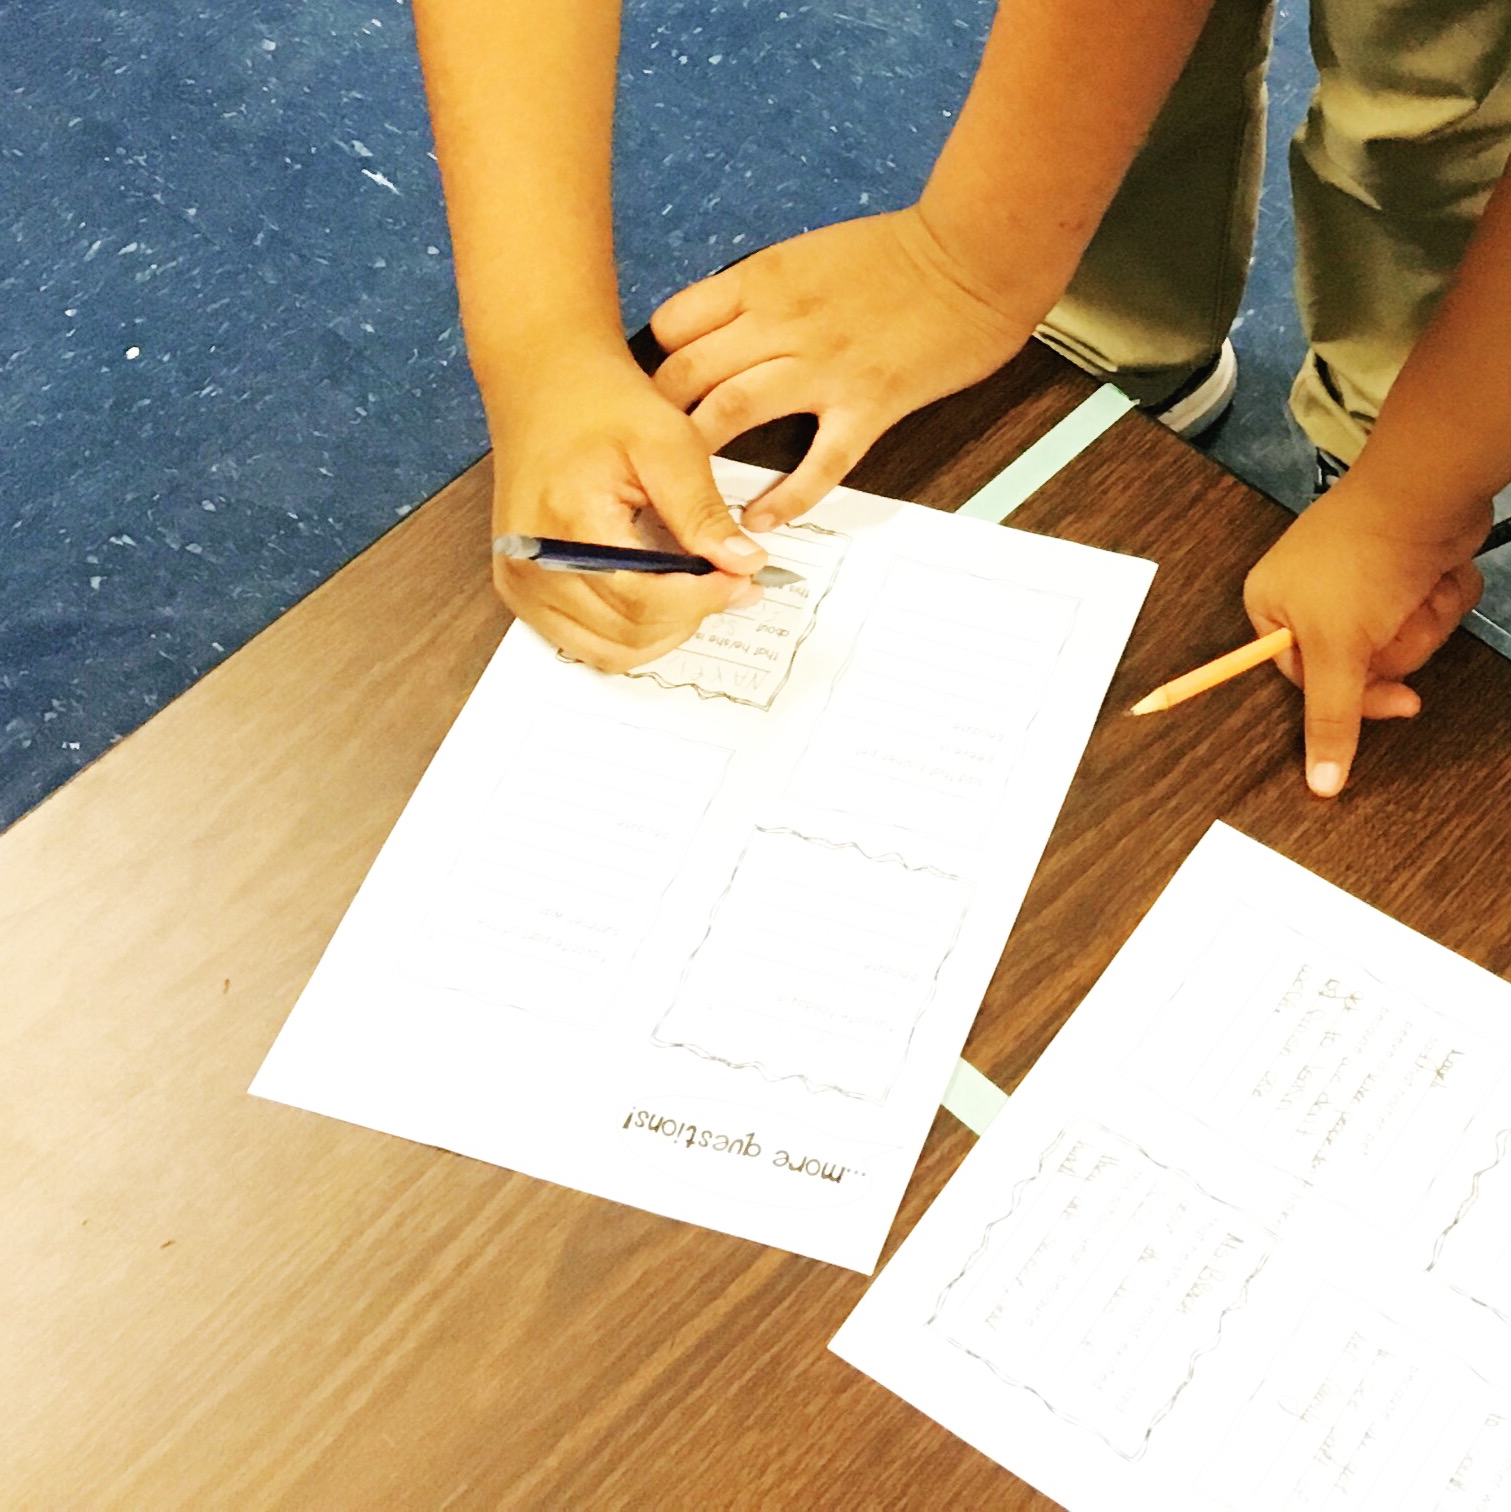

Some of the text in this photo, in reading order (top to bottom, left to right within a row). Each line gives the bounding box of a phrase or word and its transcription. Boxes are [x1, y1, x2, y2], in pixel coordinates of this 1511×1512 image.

[754, 621, 790, 640] about
[706, 634, 750, 654] he/she
[752, 645, 779, 661] that
[622, 1105, 762, 1159] questions!
